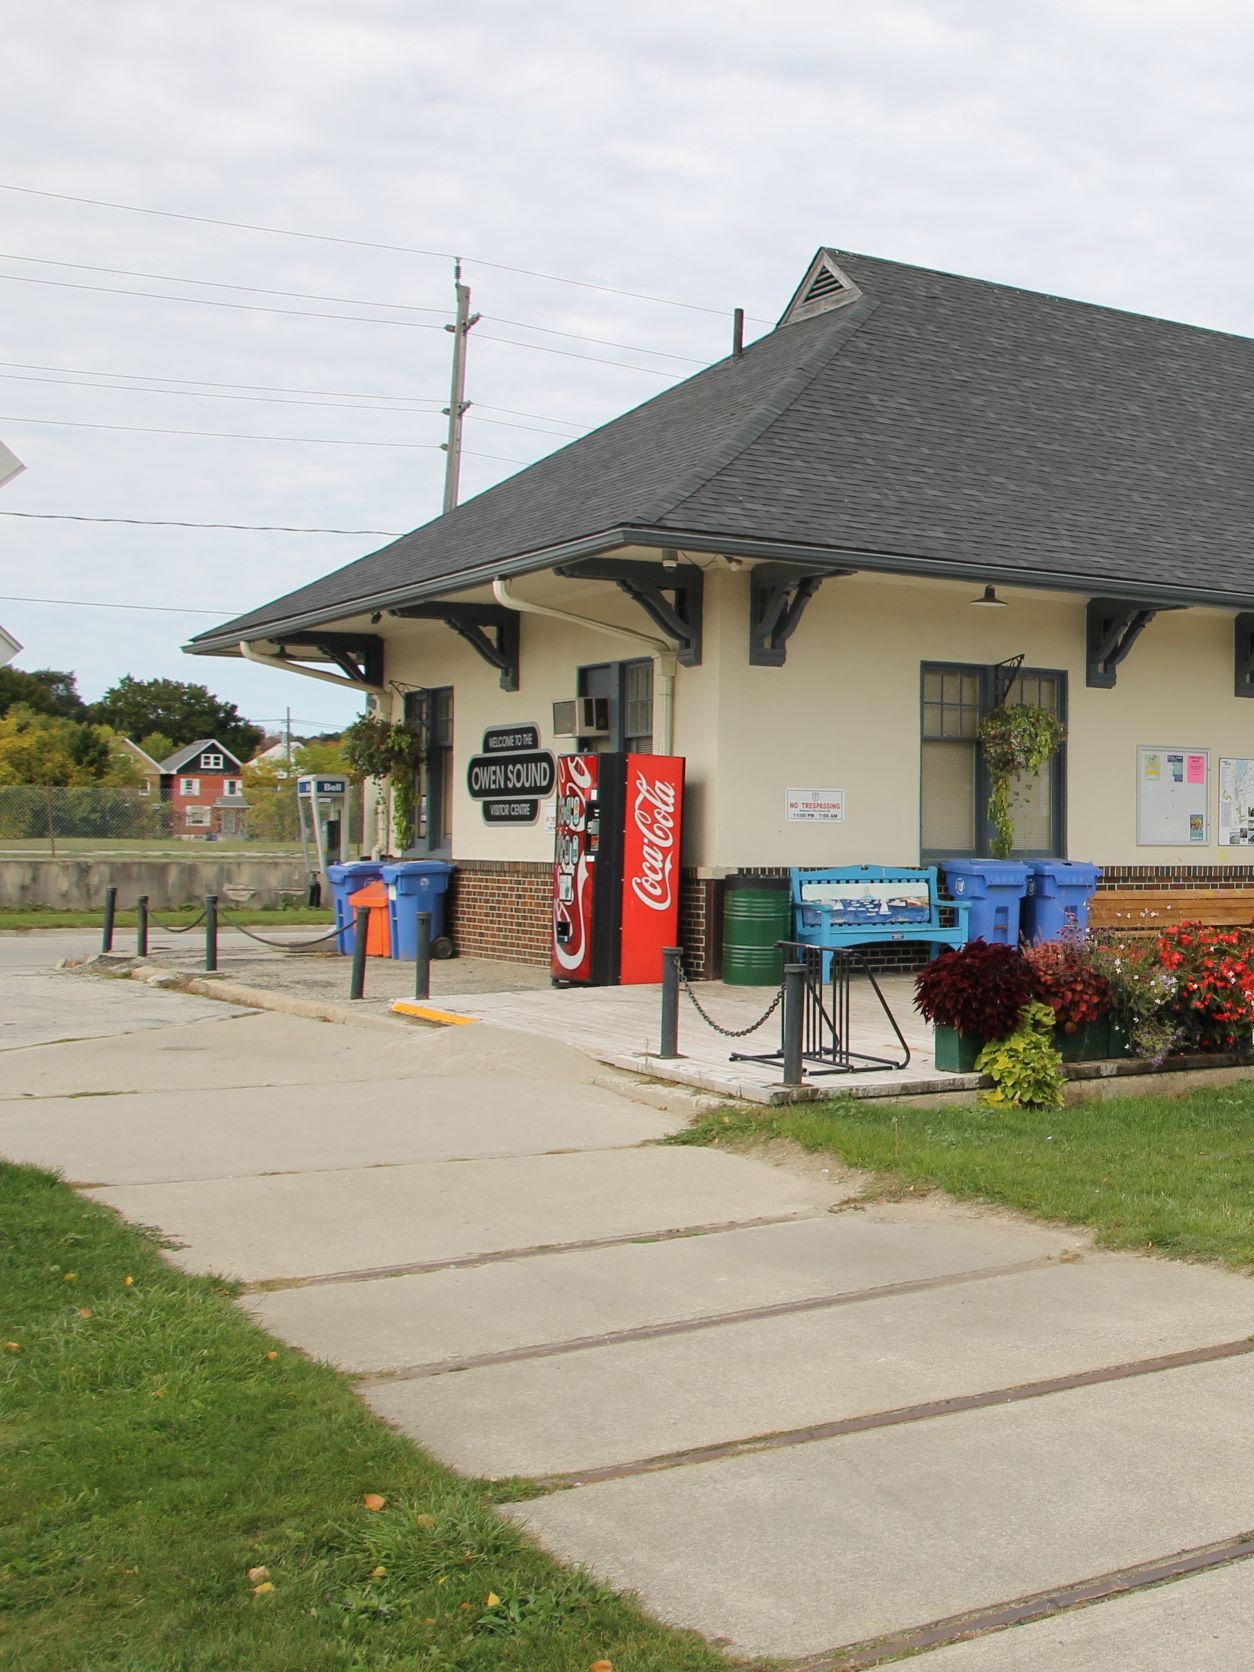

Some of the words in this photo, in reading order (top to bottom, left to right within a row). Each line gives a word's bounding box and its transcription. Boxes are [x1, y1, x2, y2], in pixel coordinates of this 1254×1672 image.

[488, 735, 514, 748] WELCOME
[515, 734, 522, 745] TO
[523, 733, 533, 745] THE
[472, 765, 504, 790] OWEN
[507, 762, 550, 788] SOUND
[323, 783, 342, 791] Bell
[490, 804, 509, 816] VISITOR
[510, 804, 530, 816] CENTRE
[801, 802, 841, 810] TRESPASSING
[632, 770, 676, 911] Coca-Cola
